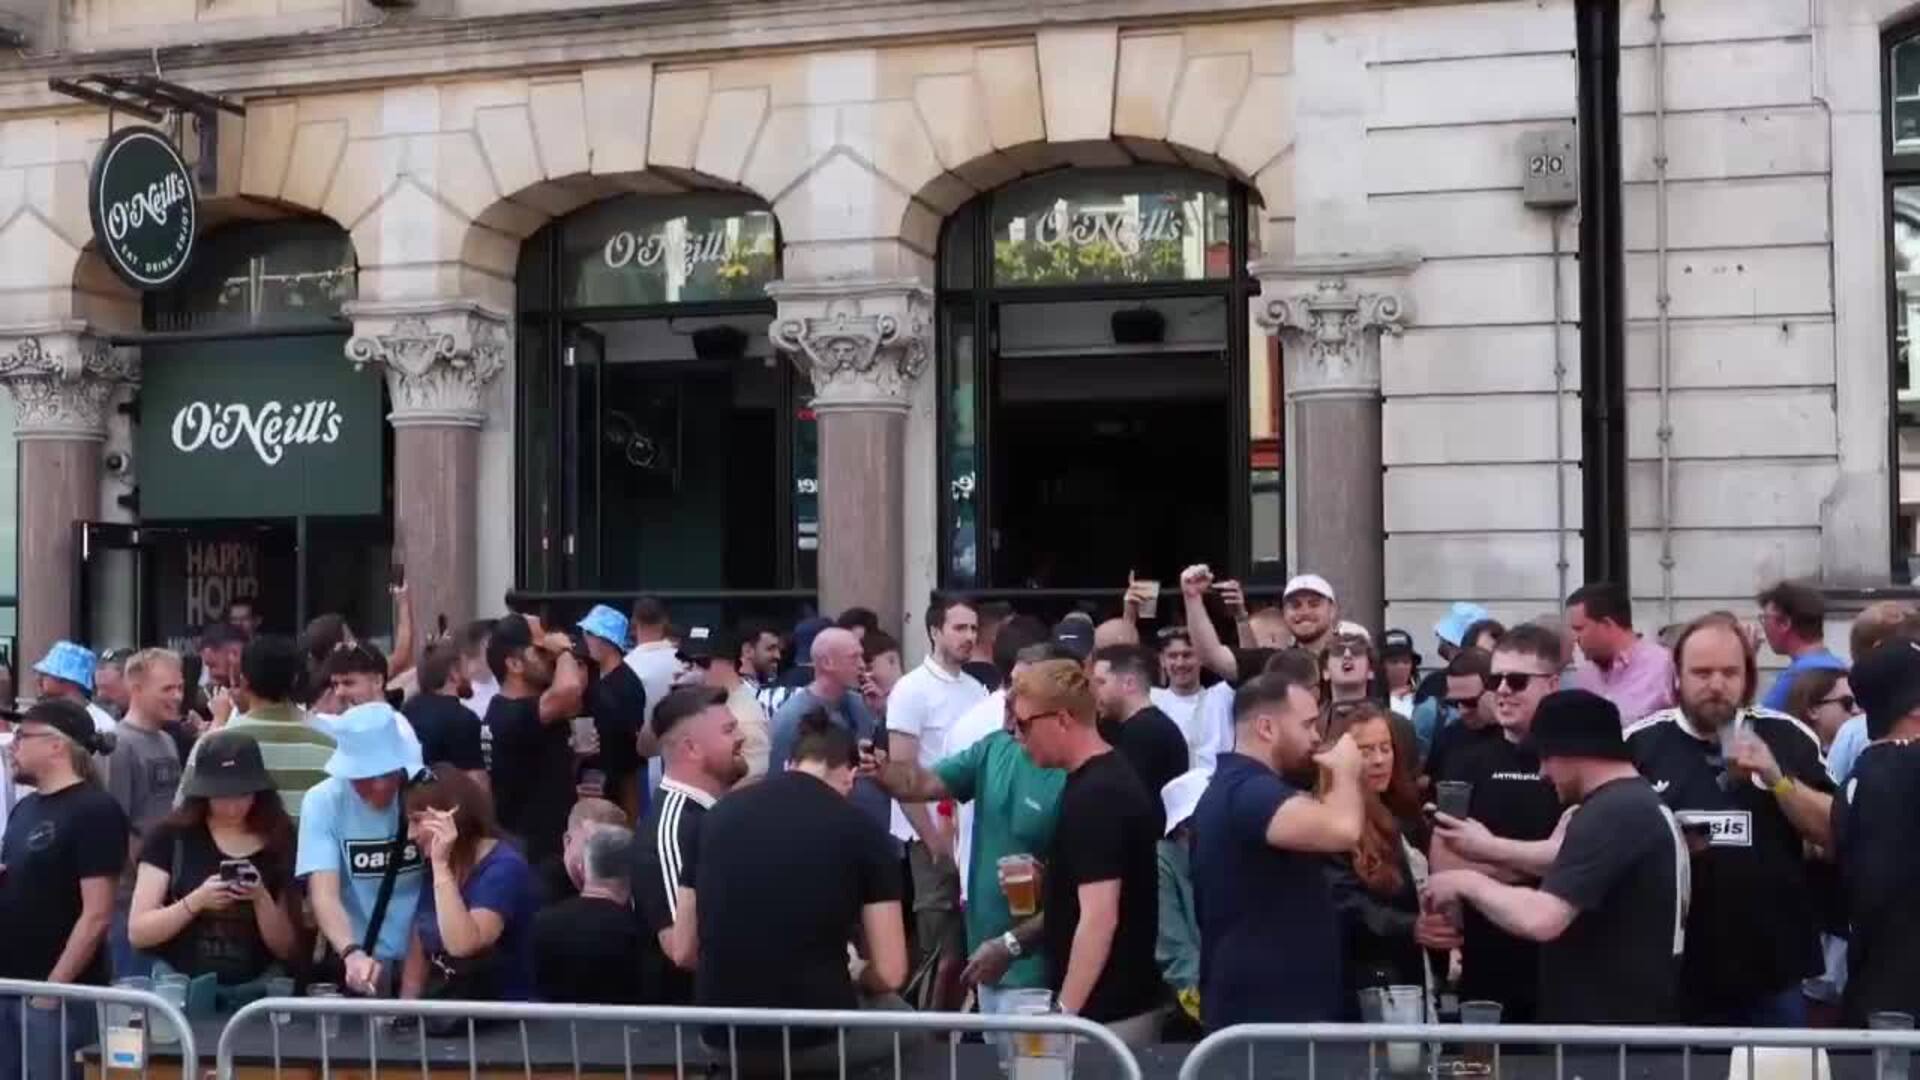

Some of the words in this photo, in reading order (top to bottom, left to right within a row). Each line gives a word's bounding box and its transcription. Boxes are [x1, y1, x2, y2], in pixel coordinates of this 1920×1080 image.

[1531, 156, 1562, 174] 20
[108, 172, 185, 240] O'Neill's
[604, 230, 733, 277] O'Nill
[171, 400, 342, 465] O'Neill's
[186, 541, 258, 574] HAPPY
[353, 845, 417, 869] oas
